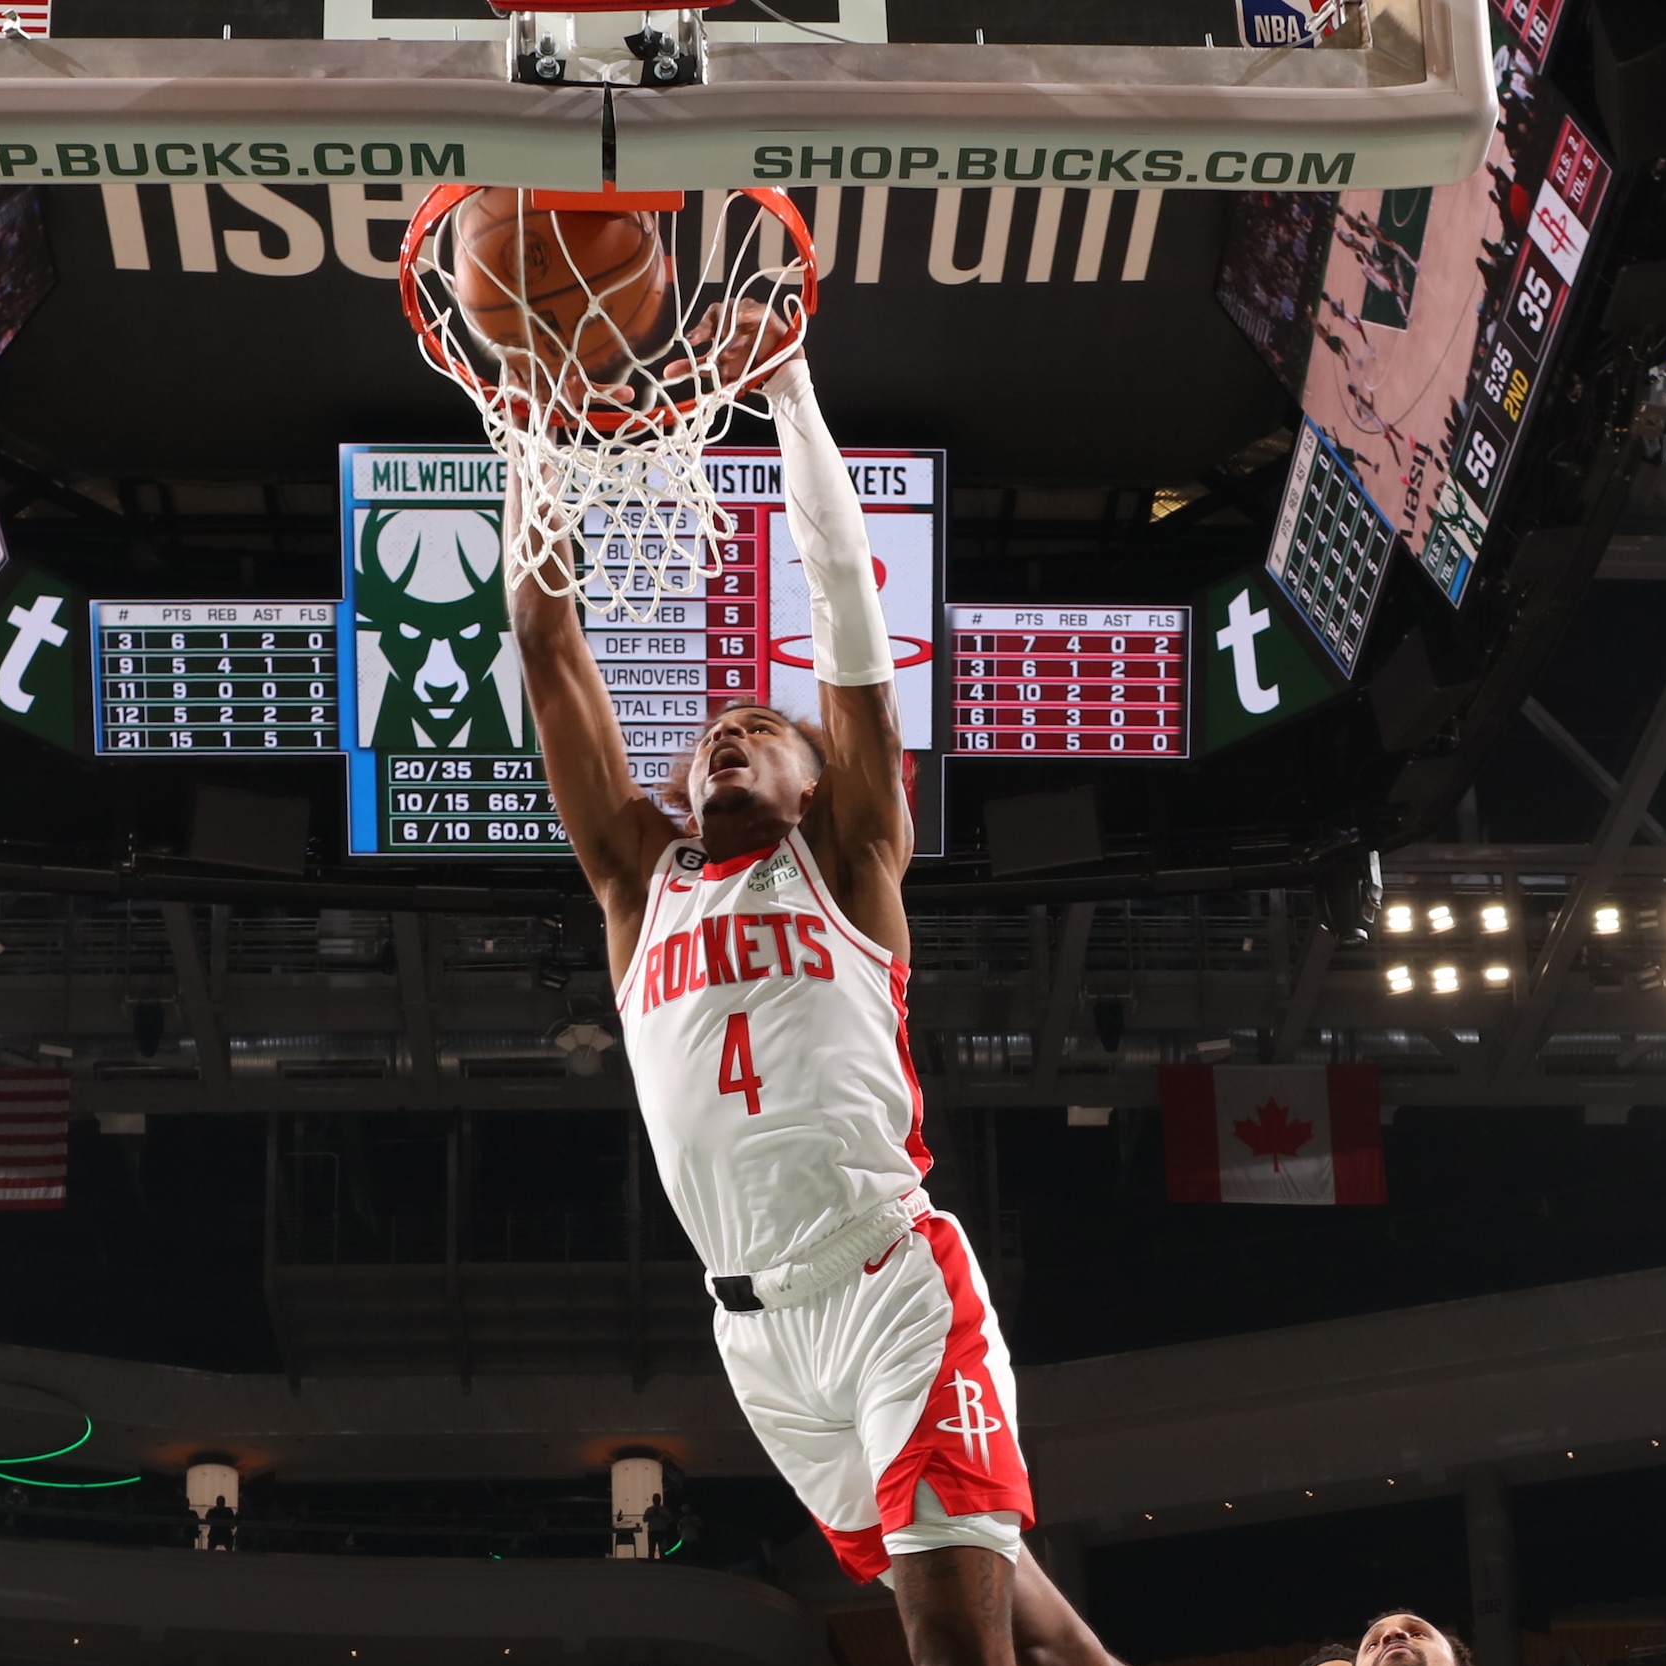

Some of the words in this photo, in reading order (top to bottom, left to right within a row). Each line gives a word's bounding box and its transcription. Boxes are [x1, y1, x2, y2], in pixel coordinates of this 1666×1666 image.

[1255, 14, 1304, 44] NBA
[752, 146, 1356, 184] SHOP.BUCKS.COM
[1555, 154, 1573, 185] FLS:
[1568, 135, 1579, 151] 2
[1569, 171, 1588, 203] TOL:
[1582, 154, 1594, 170] 5
[1517, 266, 1553, 333] 35
[1484, 341, 1514, 403] 5:35
[1503, 368, 1530, 422] 2ND
[1465, 430, 1498, 489] 56
[724, 543, 739, 562] 3
[724, 575, 739, 594] 2
[162, 609, 192, 622] PTS
[207, 609, 237, 622] REB
[253, 609, 283, 622] AST
[299, 609, 327, 622] FLS
[724, 606, 739, 625] 5
[118, 633, 133, 650] 3
[171, 633, 185, 650] 6
[219, 633, 229, 650] 1
[261, 633, 275, 650] 2
[308, 633, 323, 650] 0
[606, 637, 642, 654] DEF
[648, 637, 686, 654] REB
[719, 637, 744, 656] 15
[726, 669, 741, 688] 6
[663, 700, 698, 717] FLS
[662, 731, 696, 747] PTS
[493, 761, 533, 779] 57.1
[488, 793, 537, 812] 66.7
[488, 822, 540, 841] 60.0
[683, 851, 703, 867] 6
[643, 914, 835, 1015] ROCKETS
[718, 1012, 763, 1116] 4
